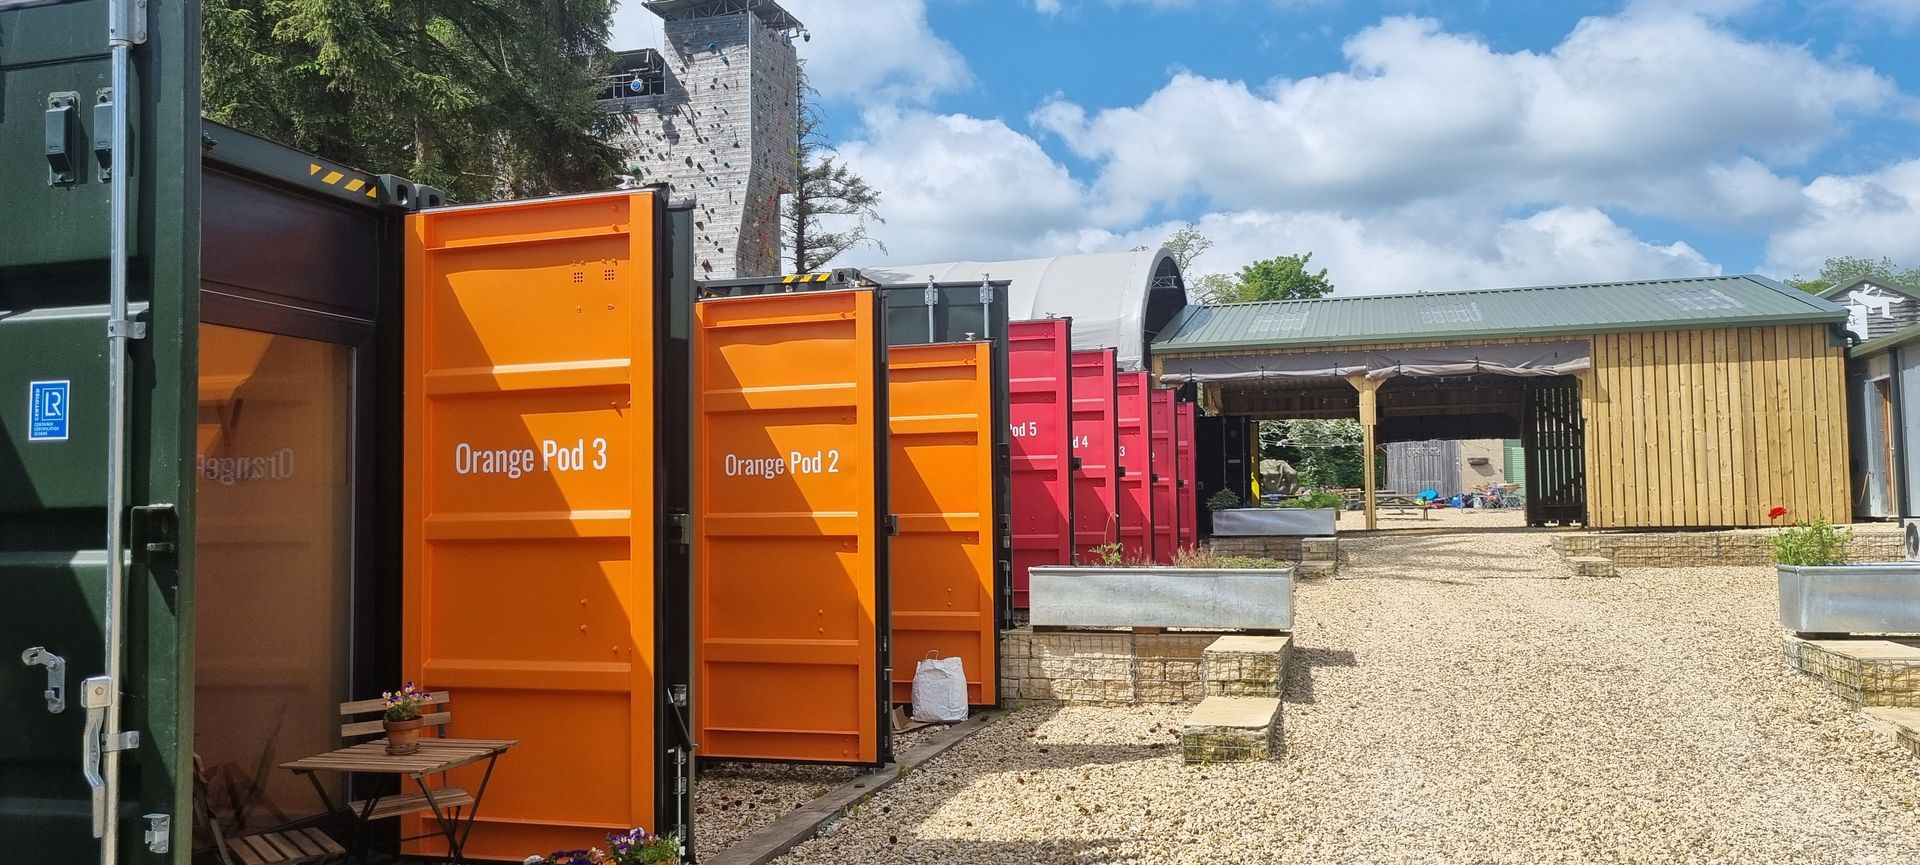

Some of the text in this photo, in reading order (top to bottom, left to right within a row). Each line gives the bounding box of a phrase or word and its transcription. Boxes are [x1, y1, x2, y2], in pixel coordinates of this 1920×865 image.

[45, 391, 61, 417] LR
[1029, 421, 1037, 437] 5
[1081, 435, 1089, 448] 4
[1119, 445, 1126, 457] 3
[455, 437, 607, 479] Orange Pod 3
[725, 449, 839, 479] Orange Pod 2
